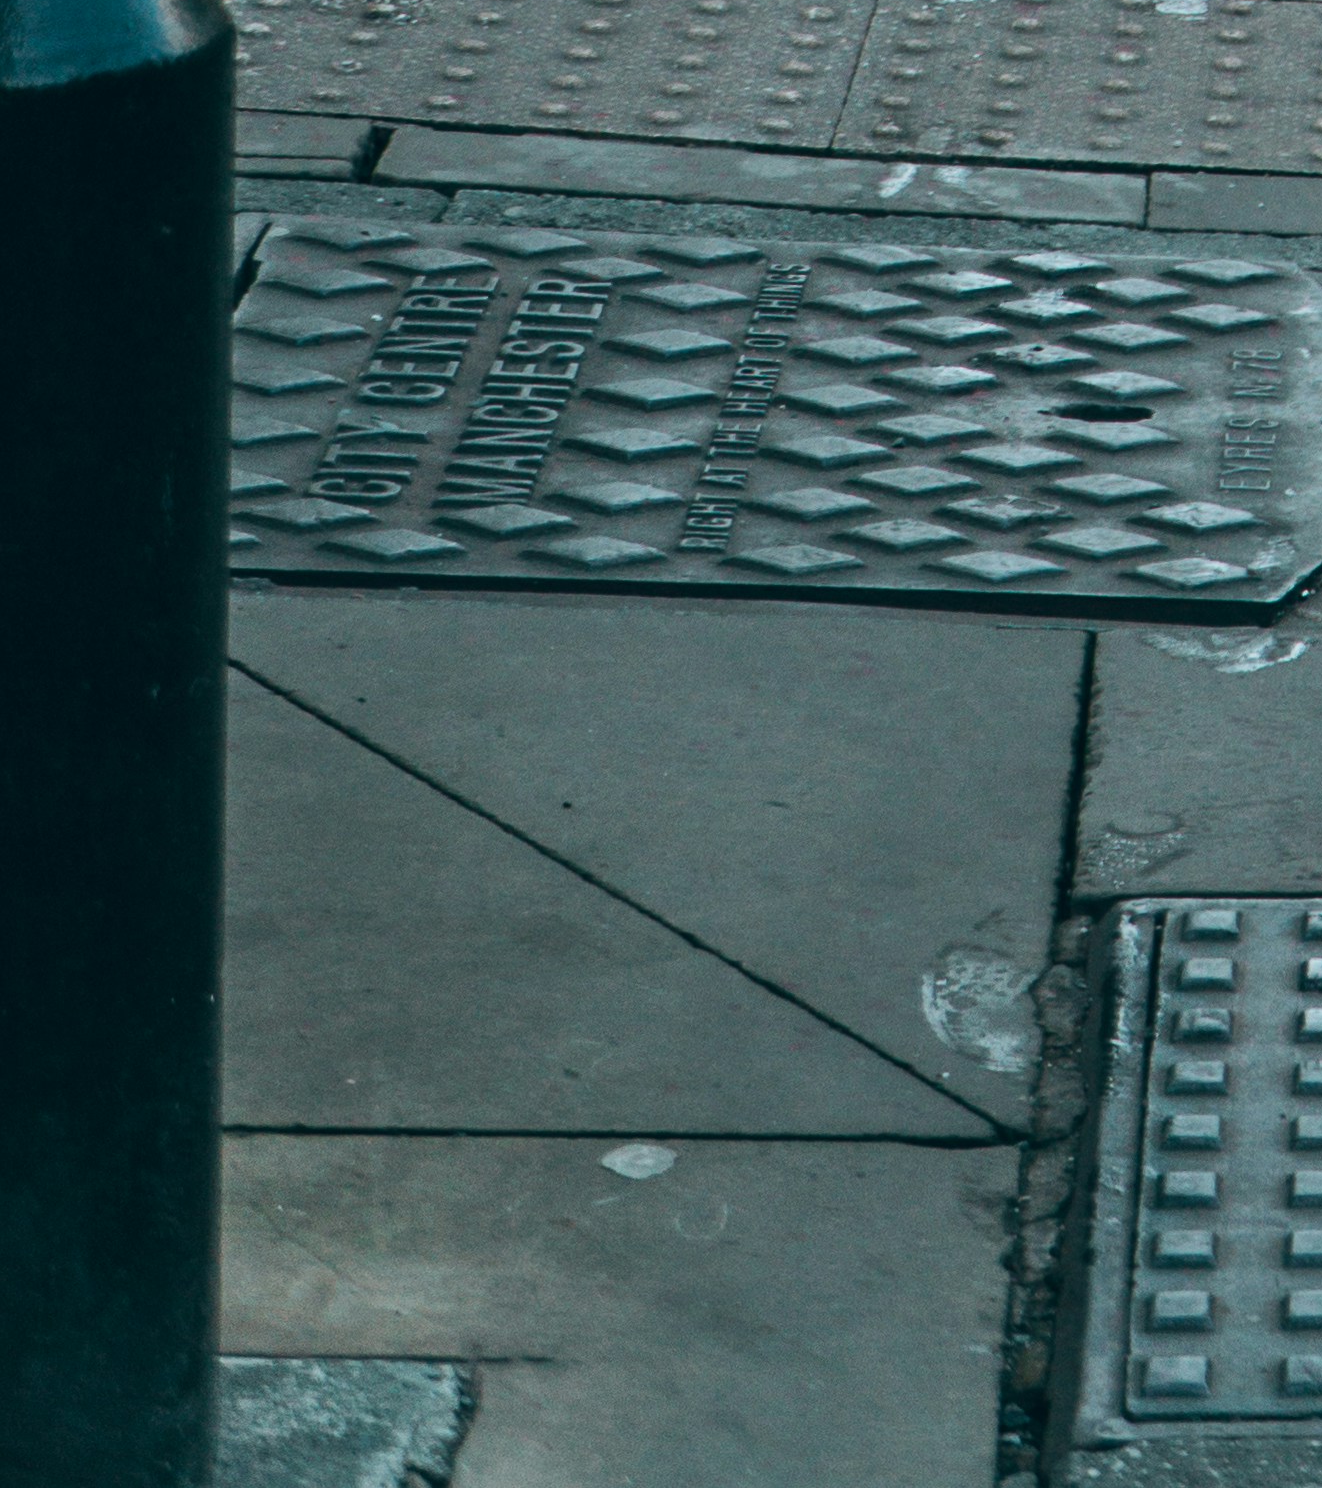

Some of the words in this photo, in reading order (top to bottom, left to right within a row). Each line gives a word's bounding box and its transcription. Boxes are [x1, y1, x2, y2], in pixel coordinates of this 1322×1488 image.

[753, 263, 811, 322] THINGS
[356, 275, 500, 406] CENTRE
[745, 327, 791, 349] OF
[431, 278, 614, 507] MANCHESTER
[720, 354, 782, 418] HEART
[309, 408, 430, 503] CITY
[708, 422, 762, 458] THE
[1220, 417, 1280, 491] EYRES
[701, 463, 748, 487] AT
[678, 492, 738, 551] RIGHT
